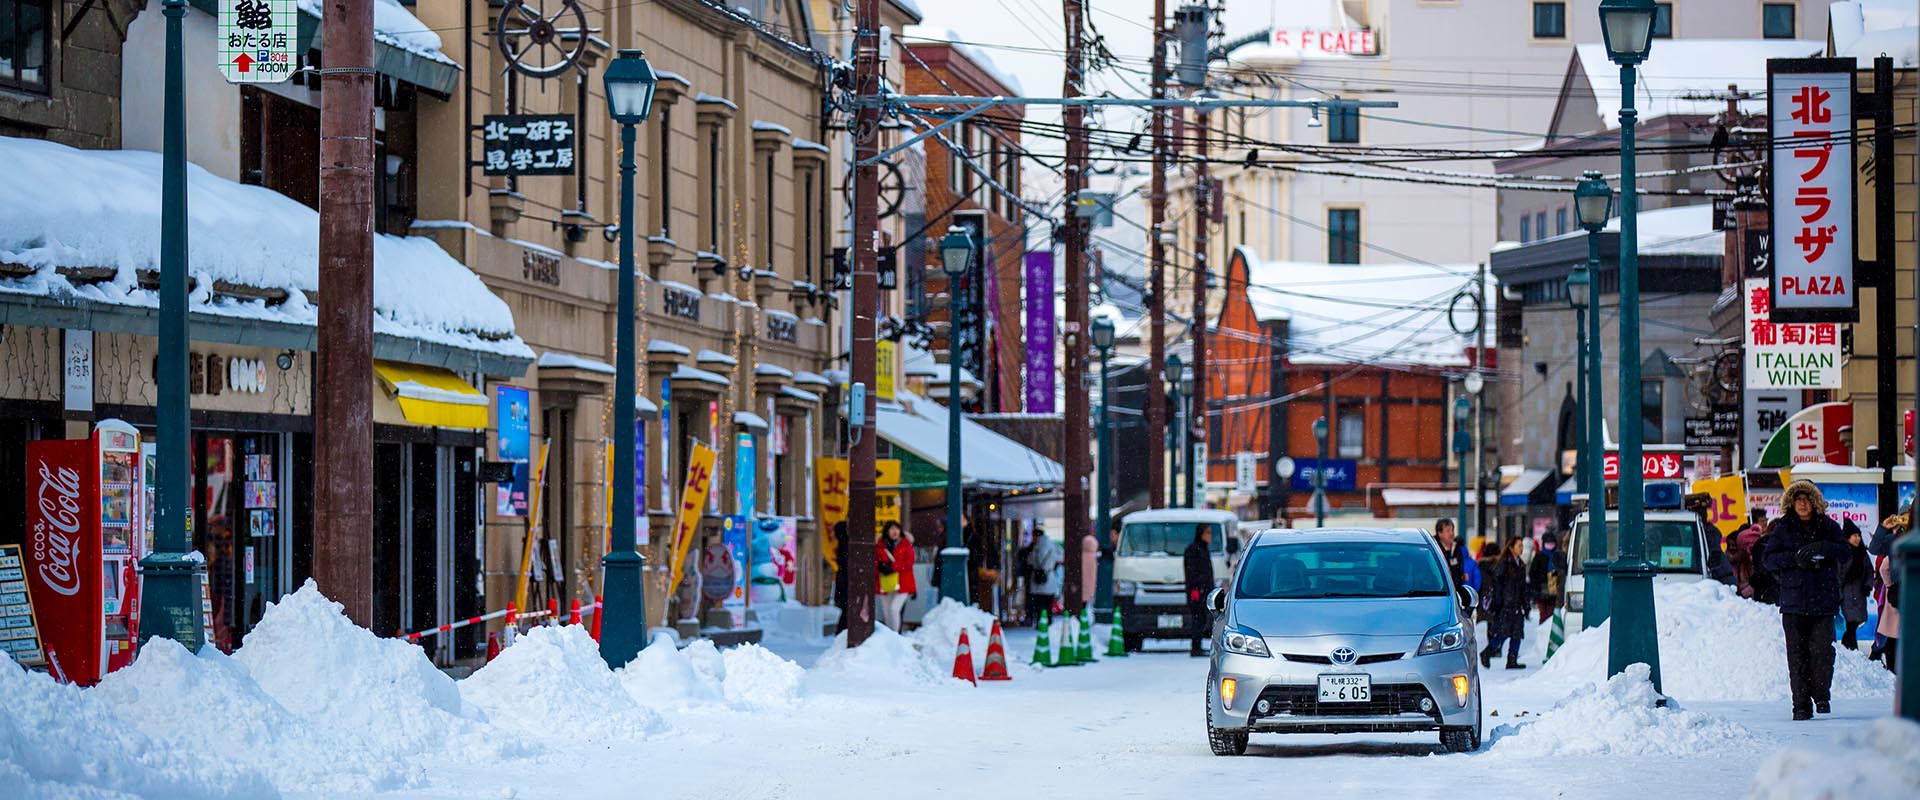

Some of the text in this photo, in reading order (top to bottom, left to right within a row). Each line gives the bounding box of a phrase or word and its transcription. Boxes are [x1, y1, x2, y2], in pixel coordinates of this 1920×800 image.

[229, 32, 287, 48] おたる店
[1320, 30, 1373, 54] CAFE
[257, 63, 288, 72] 400M
[485, 121, 573, 141] 北一硝子
[486, 149, 573, 170] 見学工房
[1791, 86, 1838, 263] 北一プラザ
[1781, 276, 1845, 295] PLAZA
[1750, 319, 1836, 345] 葡萄酒
[1756, 353, 1833, 368] ITALIAN
[1768, 370, 1821, 385] WINE
[1829, 501, 1854, 509] design
[38, 458, 80, 596] Coca-Cola
